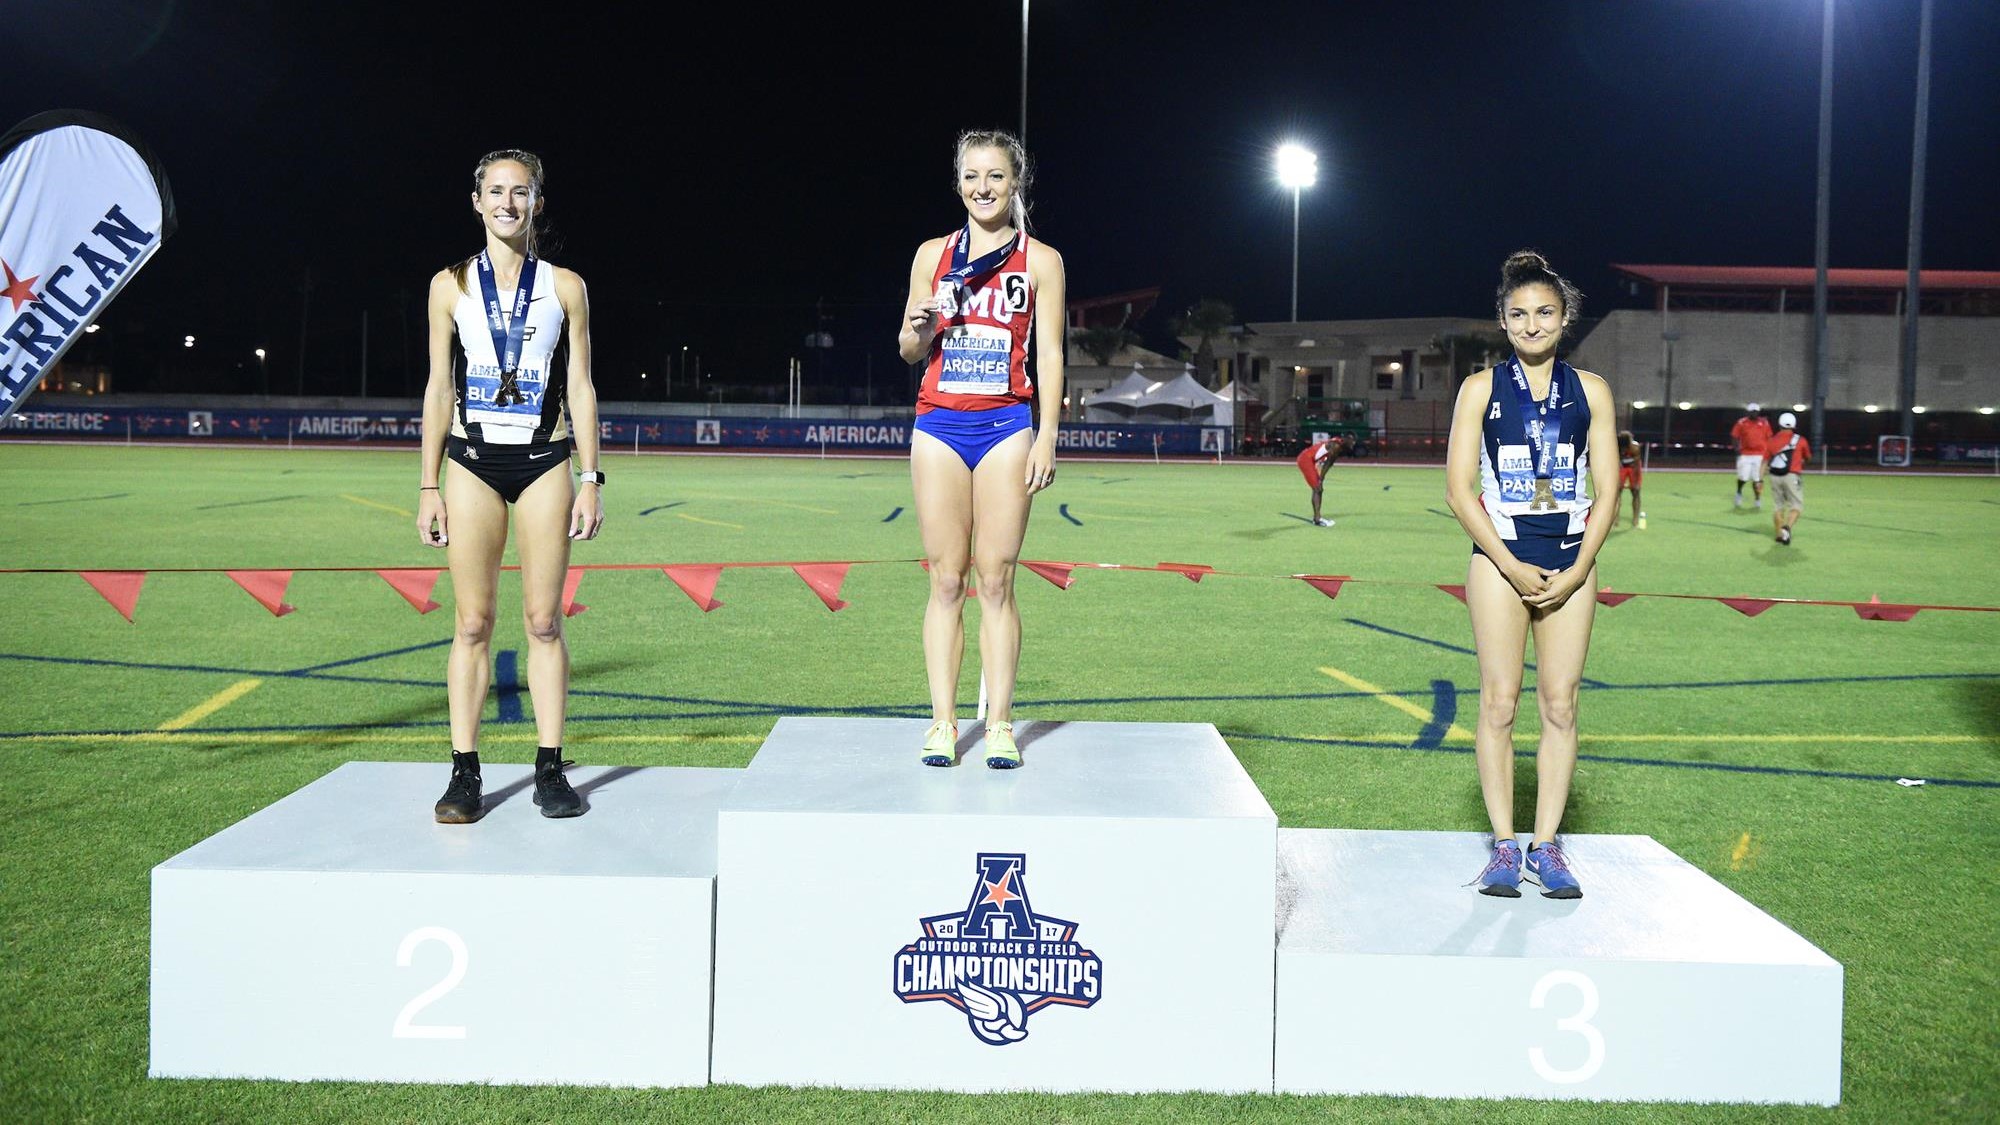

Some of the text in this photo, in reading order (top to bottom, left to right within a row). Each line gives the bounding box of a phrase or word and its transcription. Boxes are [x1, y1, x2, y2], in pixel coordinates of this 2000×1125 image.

[1006, 275, 1026, 309] 6
[0, 203, 154, 415] ERICAN
[944, 337, 1006, 350] AMERICAN
[470, 364, 539, 380] AMECAN
[943, 357, 1008, 374] ARCHER
[468, 386, 542, 406] BLAEY
[1489, 402, 1502, 419] A
[805, 425, 904, 443] AMERICAN
[1057, 429, 1117, 447] RENCE
[1503, 457, 1569, 469] AMEAN
[1503, 478, 1574, 493] PANSE
[939, 924, 1057, 937] 20 17
[920, 940, 1077, 956] OUTDOOR TRACK & FIELD
[391, 926, 469, 1039] 2
[897, 954, 1098, 998] CHAMPIONSHIPS
[1528, 969, 1606, 1084] 3
